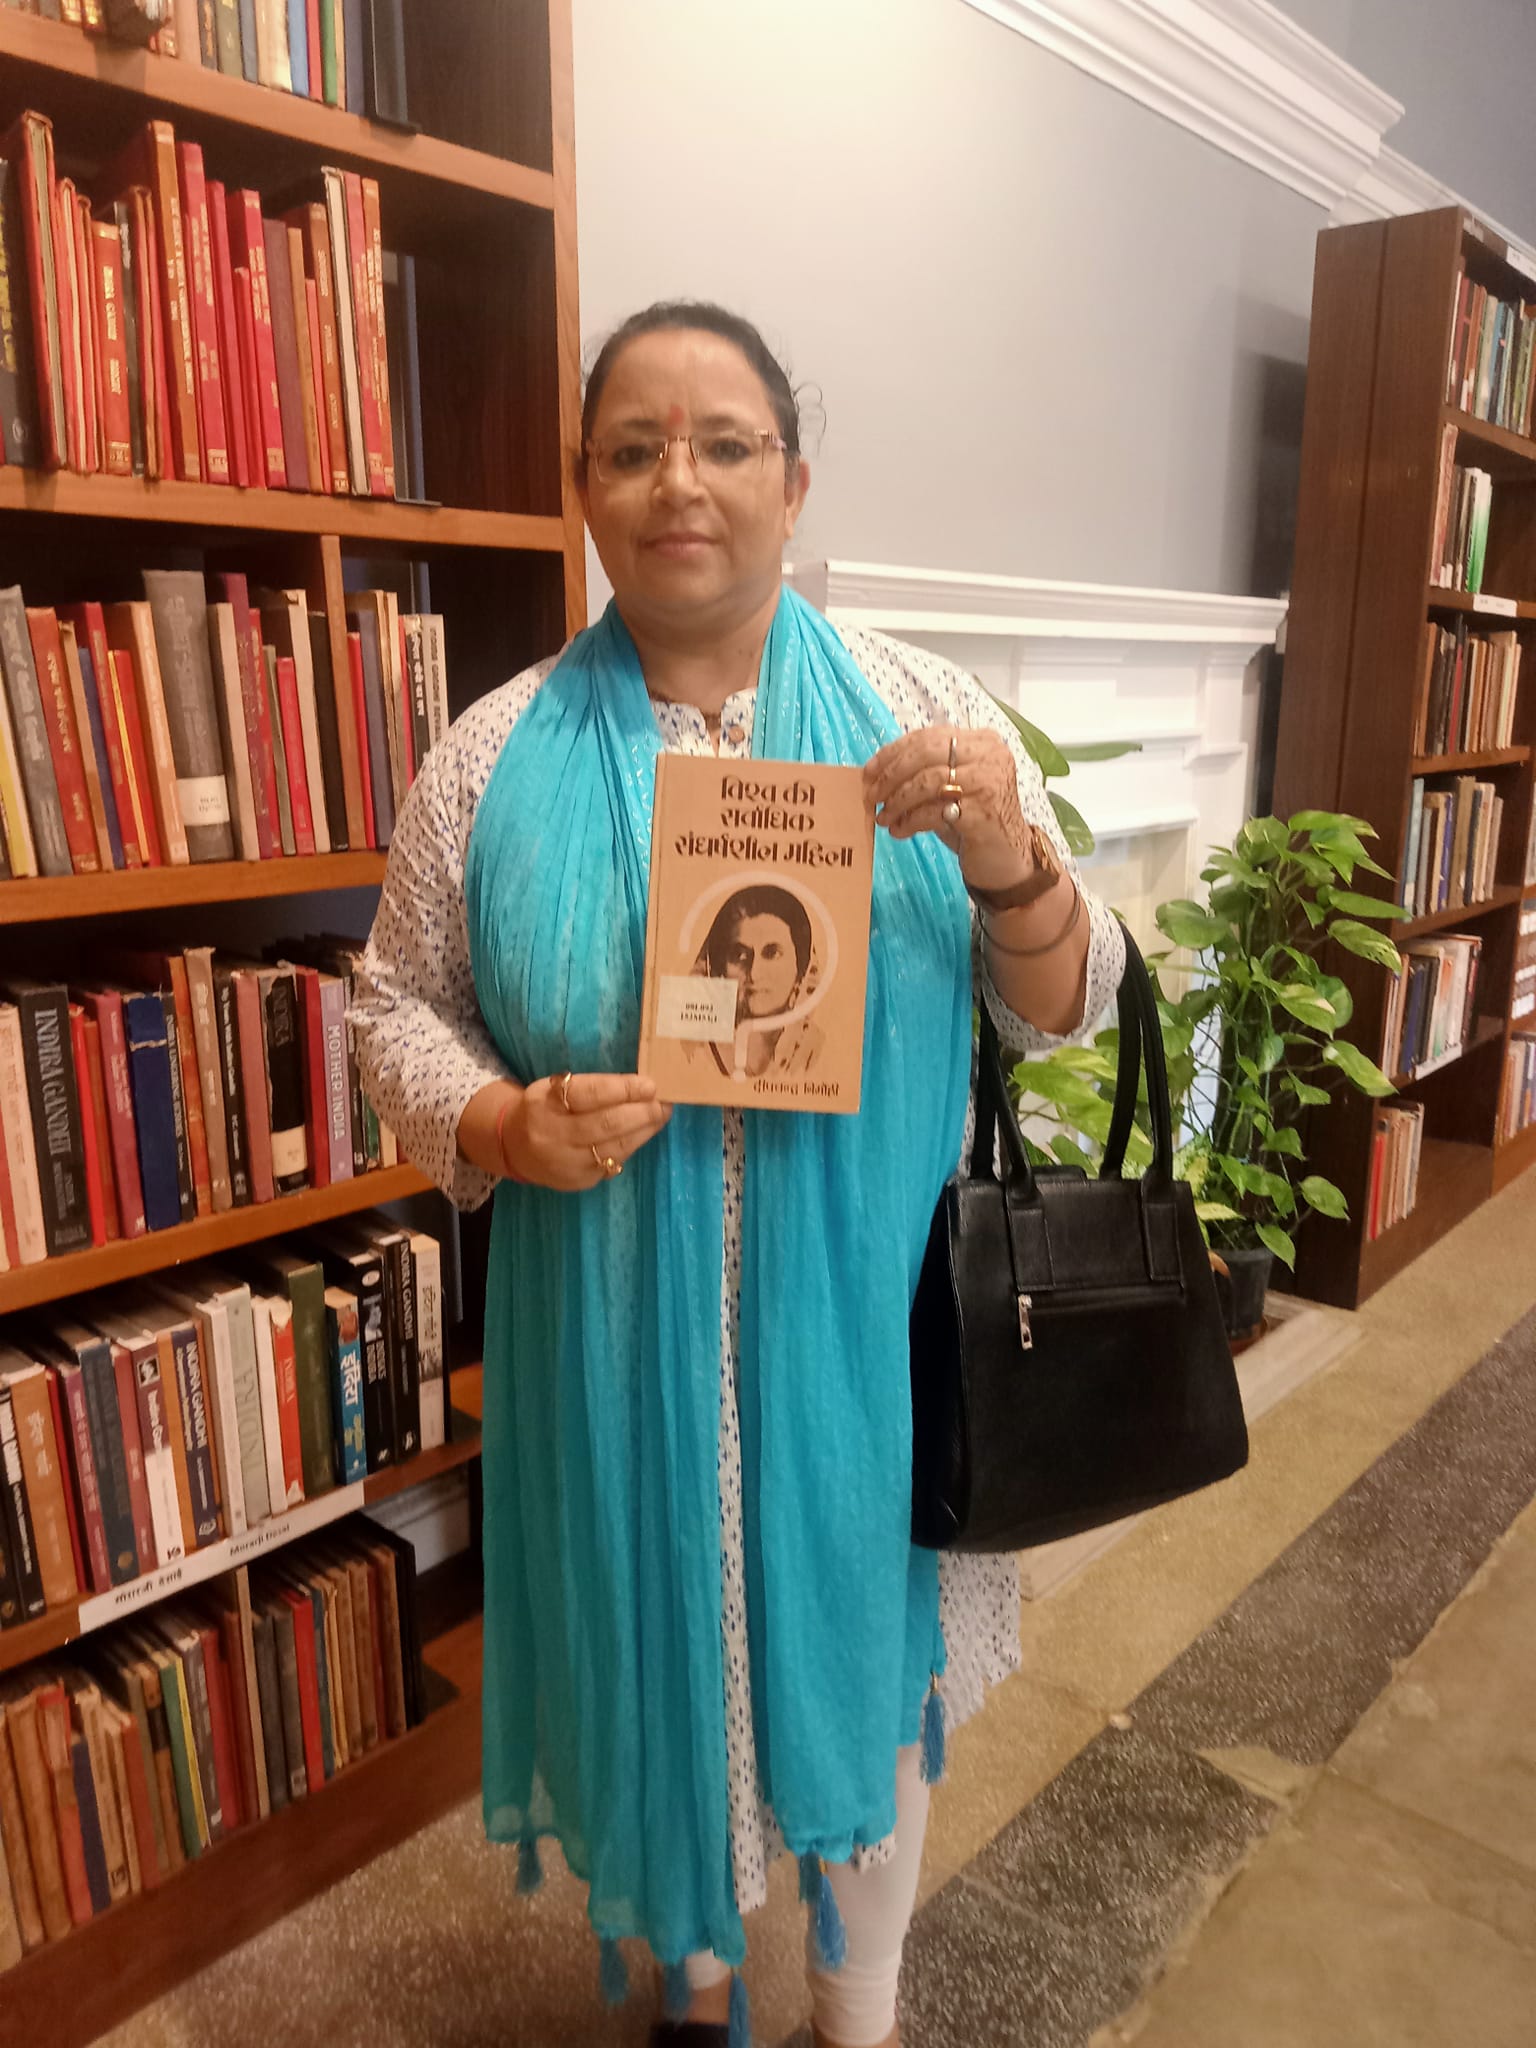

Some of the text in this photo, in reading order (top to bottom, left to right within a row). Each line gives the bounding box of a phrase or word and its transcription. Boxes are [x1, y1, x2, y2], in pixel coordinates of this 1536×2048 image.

[721, 775, 816, 806] विश्व की
[721, 803, 815, 832] सर्वाधिक
[675, 831, 853, 868] संघर्षशील महिला
[35, 1008, 64, 1081] INDIRA
[327, 1024, 345, 1141] MOTHER INDIA
[42, 1080, 72, 1156] GANDHI
[186, 1341, 201, 1393] INDIRA
[191, 1390, 208, 1449] GANDHI
